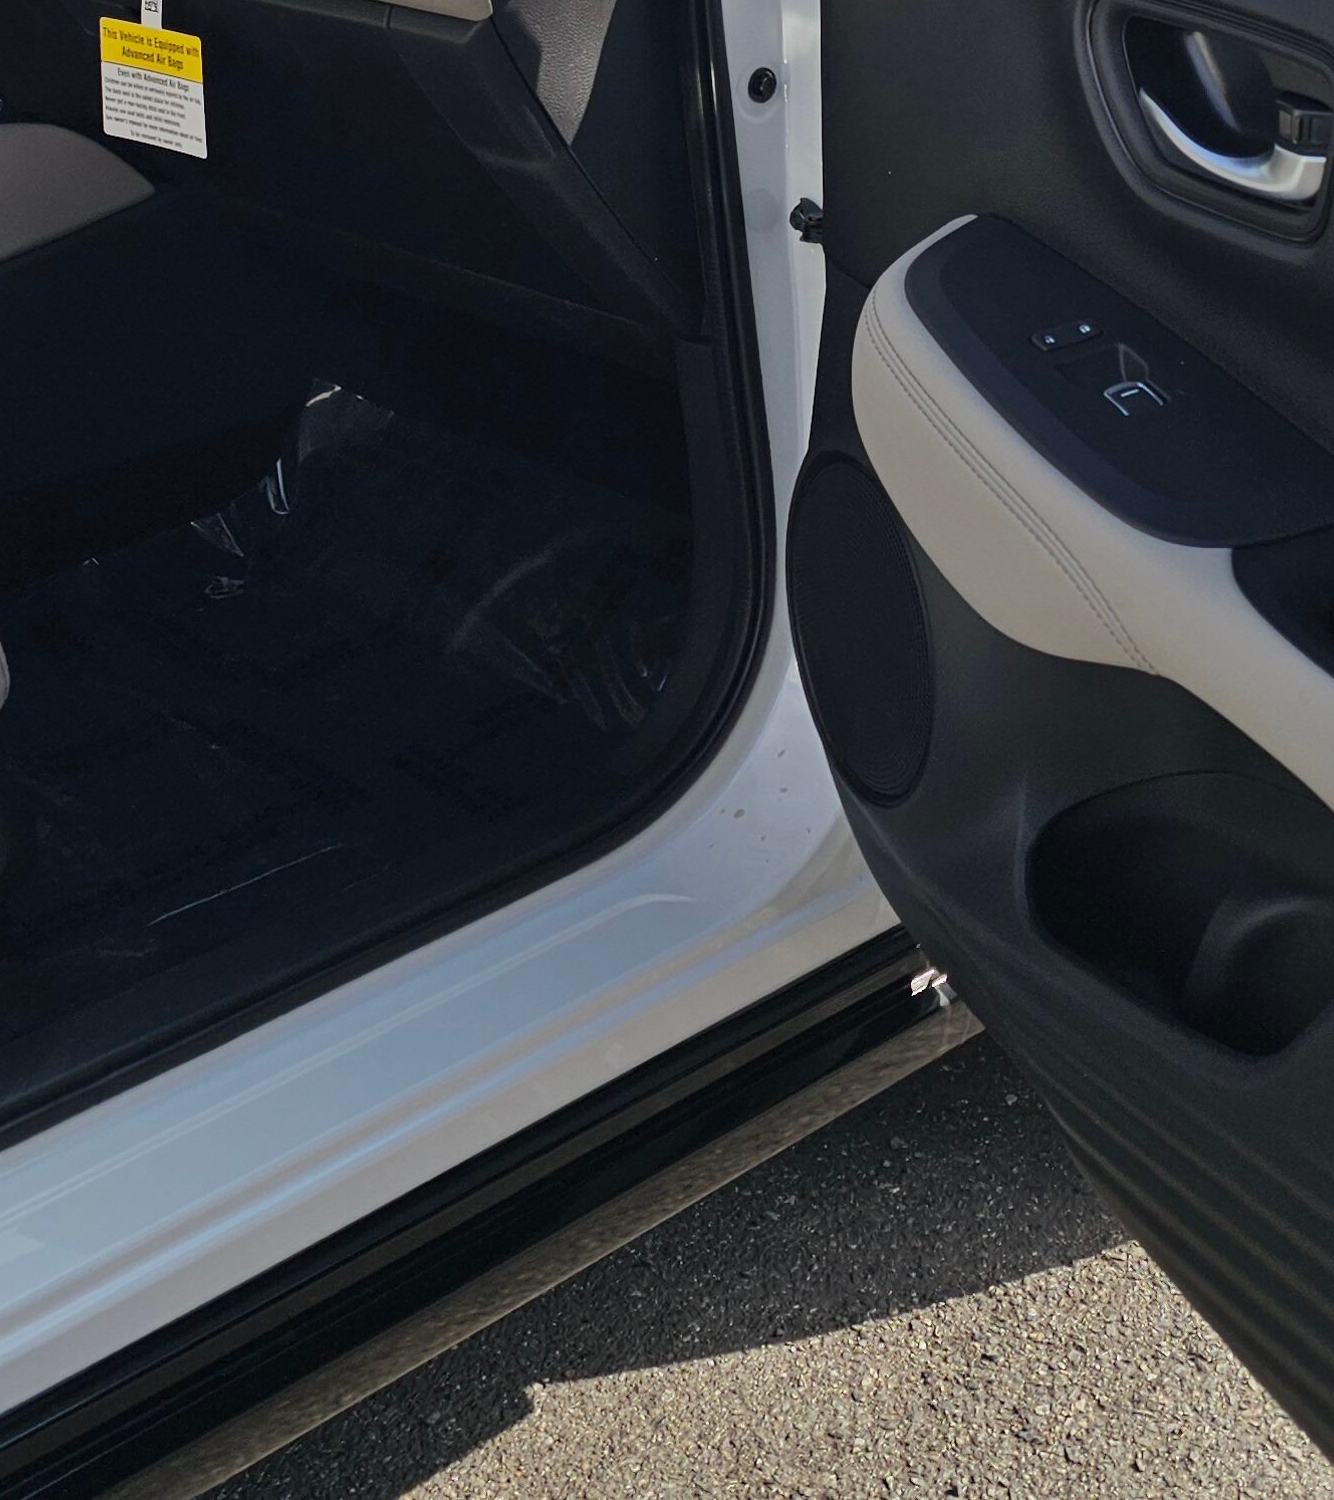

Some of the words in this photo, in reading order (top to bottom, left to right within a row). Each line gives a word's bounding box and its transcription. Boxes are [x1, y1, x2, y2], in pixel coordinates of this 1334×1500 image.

[102, 26, 117, 40] This
[119, 30, 145, 45] Vehicle
[146, 38, 153, 47] is
[154, 37, 185, 54] Equipped
[186, 45, 200, 57] with
[122, 45, 155, 63] Advanced
[156, 53, 166, 65] Air
[167, 55, 184, 71] Bags
